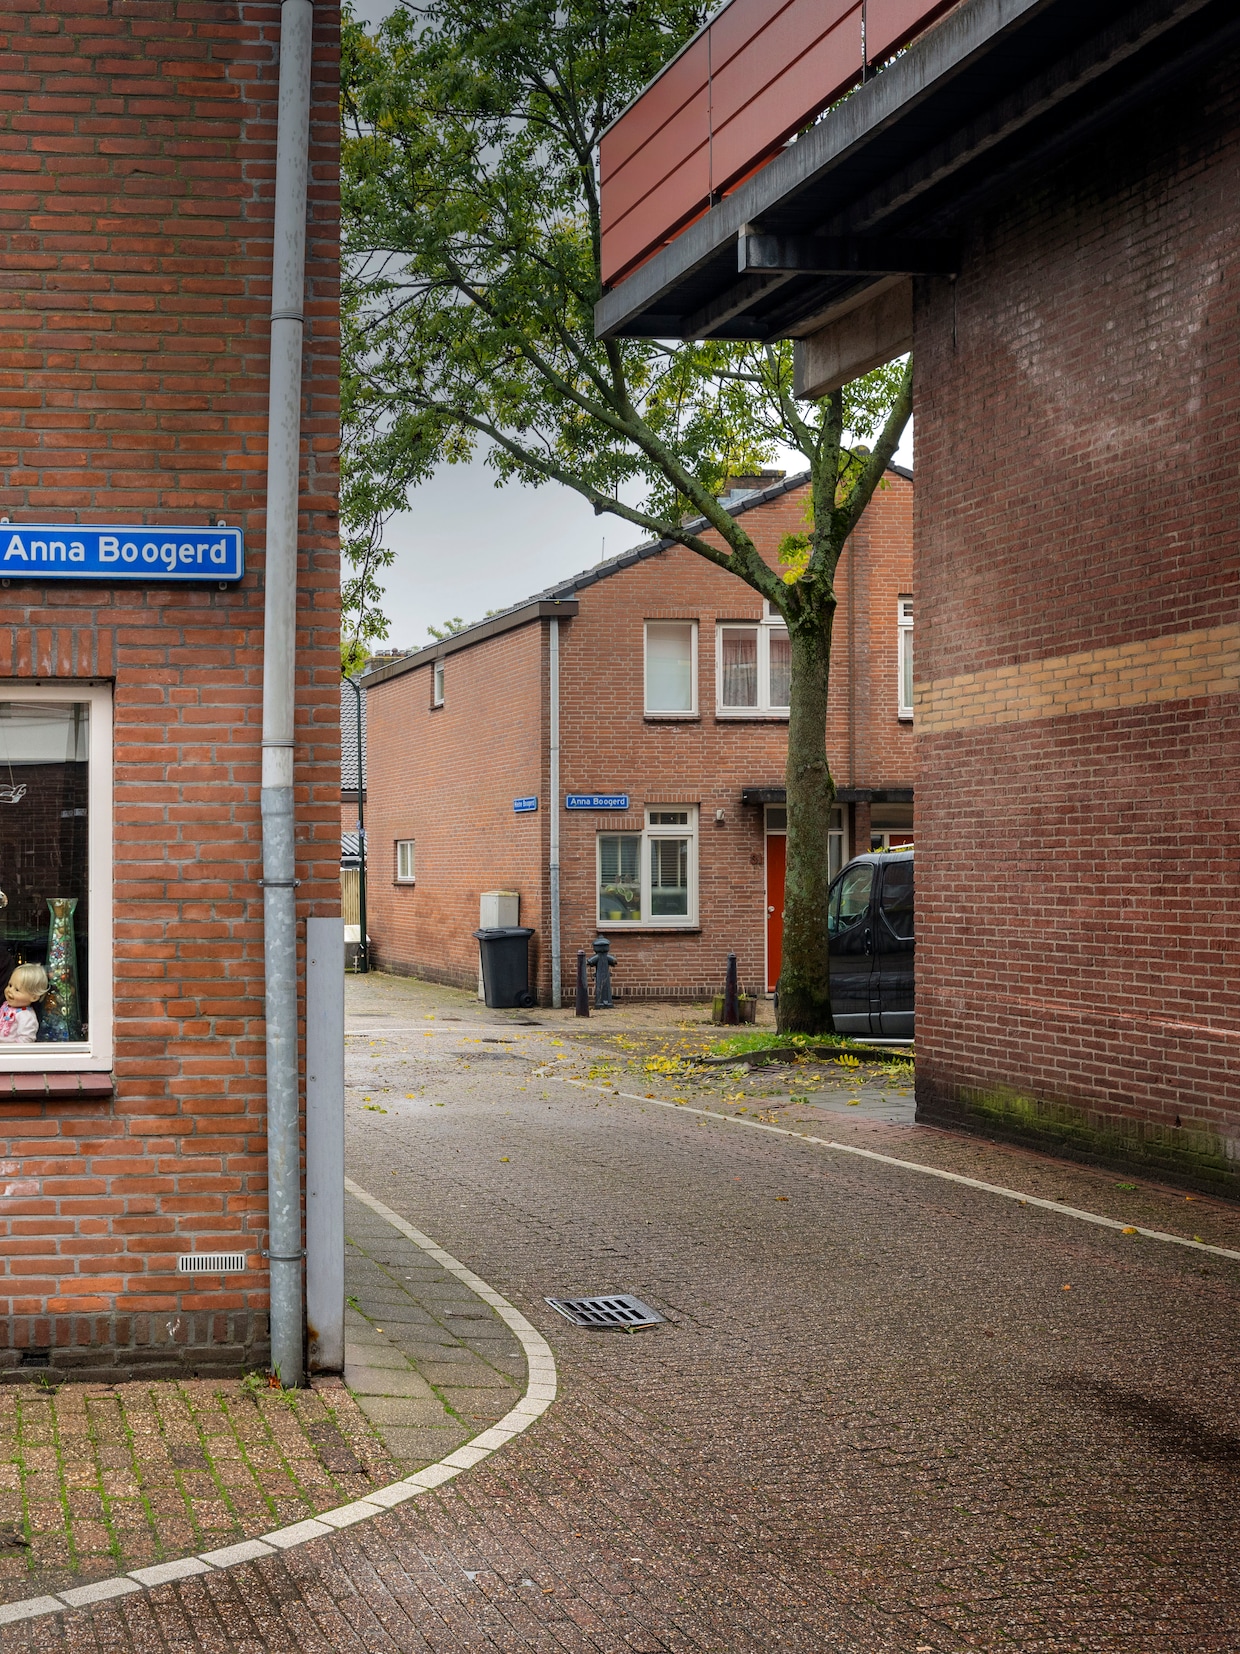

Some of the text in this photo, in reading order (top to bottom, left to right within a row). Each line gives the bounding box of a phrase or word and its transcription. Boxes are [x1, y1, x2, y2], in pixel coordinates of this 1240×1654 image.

[3, 534, 227, 572] Anna Boogerd
[570, 797, 625, 807] Anna Boogerd
